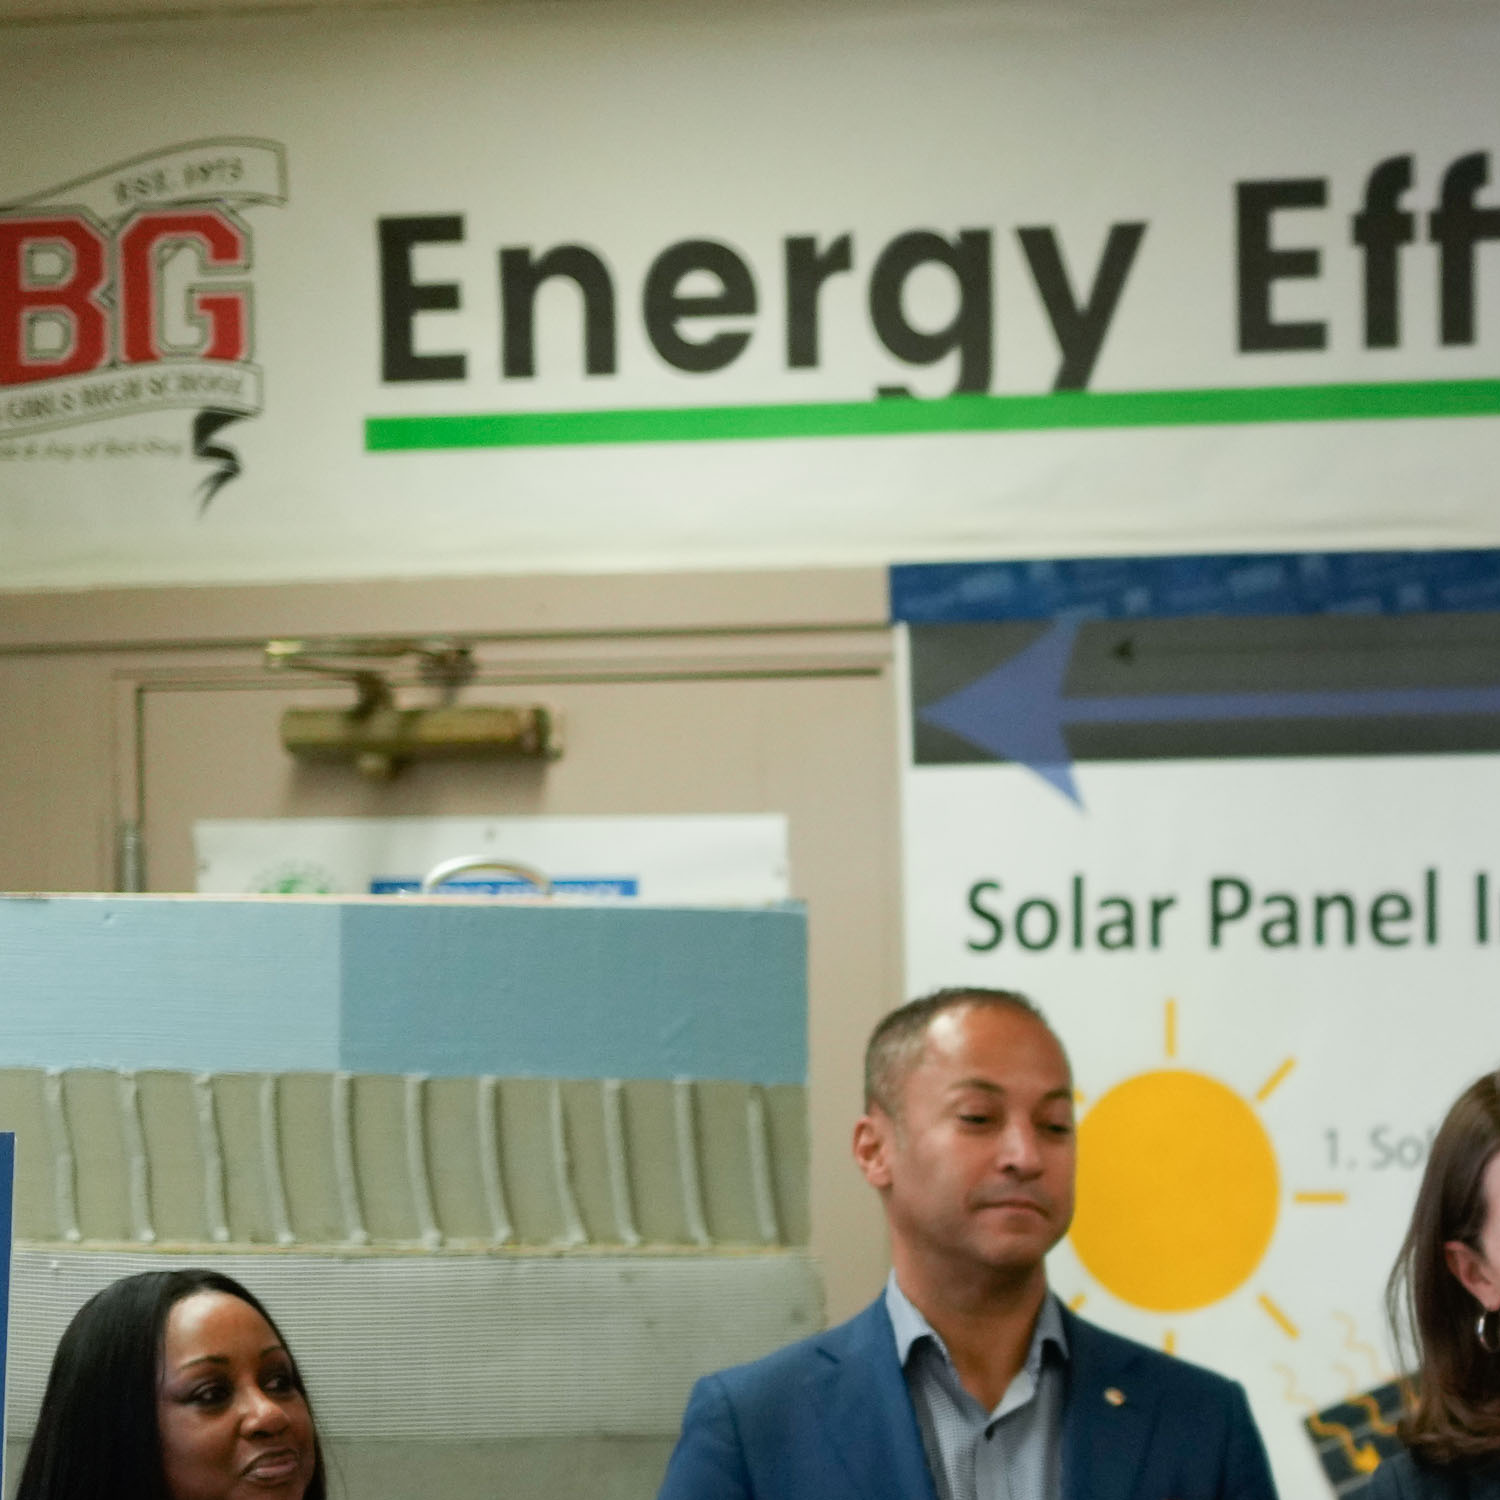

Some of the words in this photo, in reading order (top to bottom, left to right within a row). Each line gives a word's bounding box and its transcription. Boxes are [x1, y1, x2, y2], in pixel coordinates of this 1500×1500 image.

[378, 211, 1150, 399] Energy
[965, 873, 1180, 954] Solar
[1208, 866, 1438, 950] Panel
[1324, 1125, 1358, 1169] 1.
